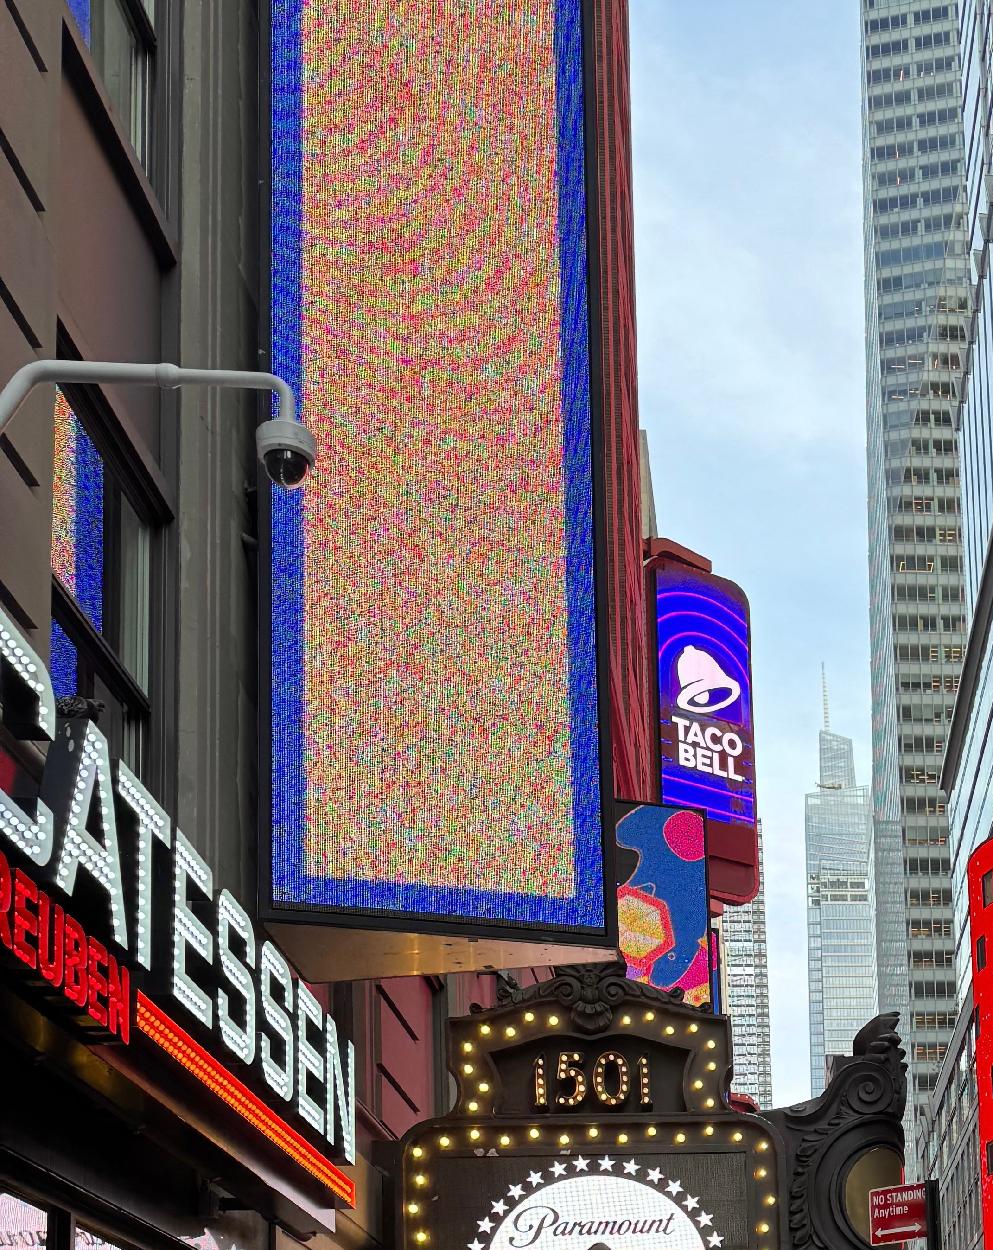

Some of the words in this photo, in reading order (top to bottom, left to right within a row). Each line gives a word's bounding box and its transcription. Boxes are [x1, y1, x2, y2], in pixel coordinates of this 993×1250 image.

[672, 715, 743, 757] TACO
[678, 741, 744, 781] BELL
[534, 1051, 653, 1106] 1501
[873, 1195, 885, 1206] NO
[873, 1205, 909, 1219] Anytime
[508, 1205, 676, 1248] Paramount
